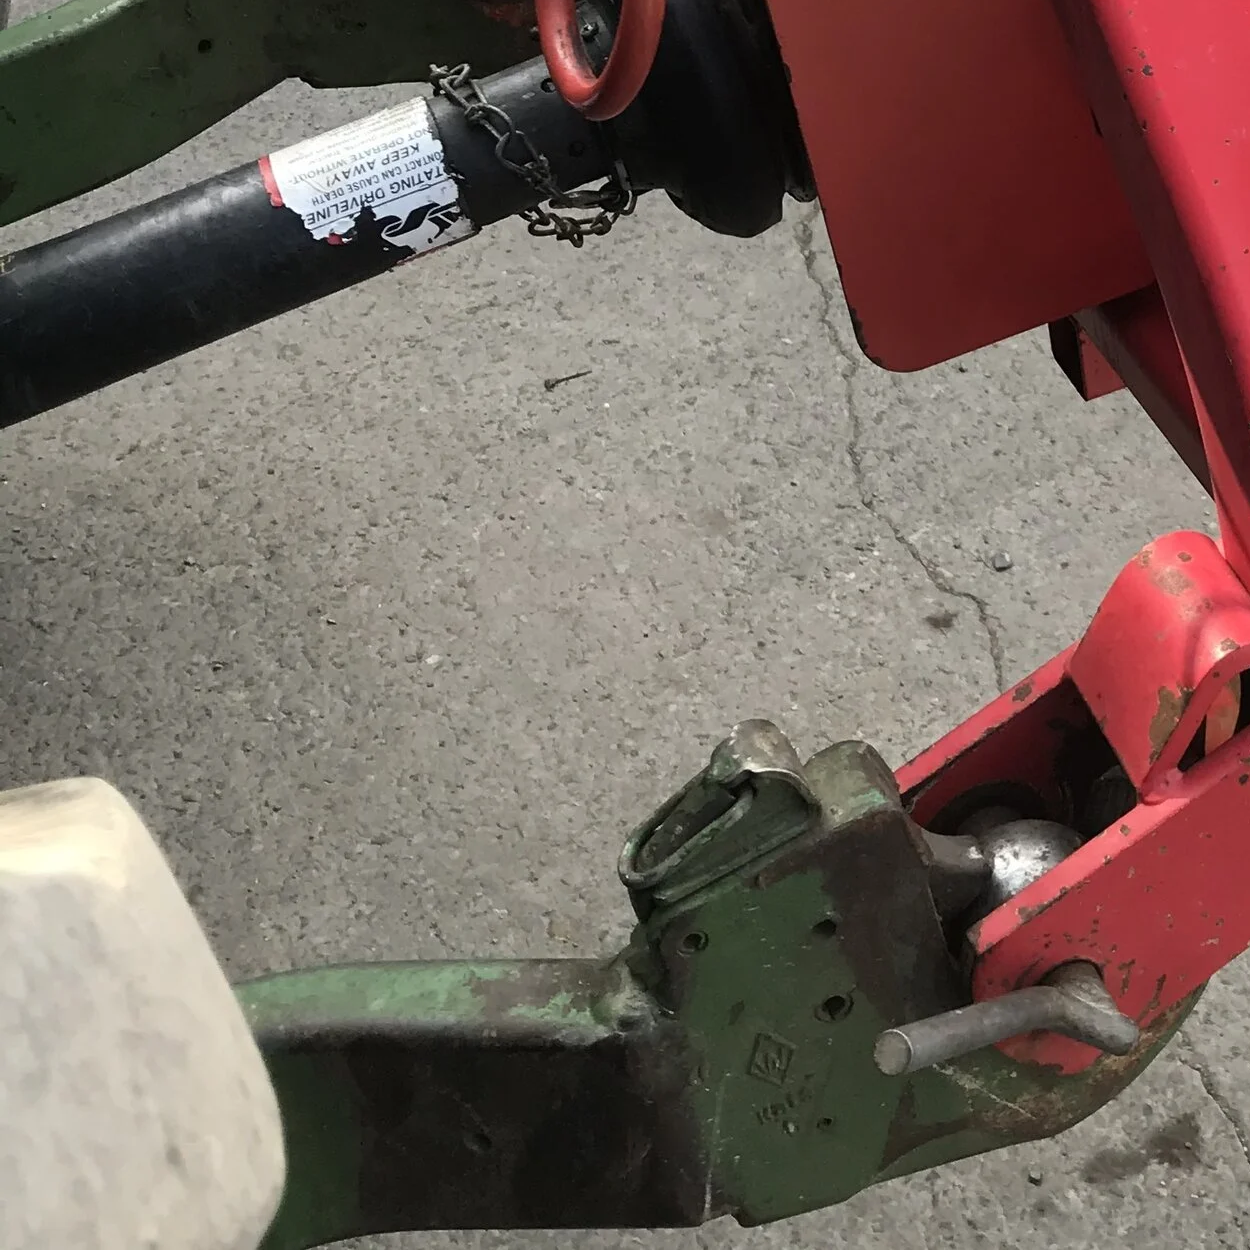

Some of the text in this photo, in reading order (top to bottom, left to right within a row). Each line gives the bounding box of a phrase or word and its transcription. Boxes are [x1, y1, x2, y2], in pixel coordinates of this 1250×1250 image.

[349, 136, 405, 162] OPERATE
[325, 142, 421, 187] KEEP AWAY!
[381, 165, 402, 181] CAN
[346, 174, 380, 193] CAUSE
[305, 187, 385, 225] DRIVELINE
[311, 186, 345, 207] DEATH
